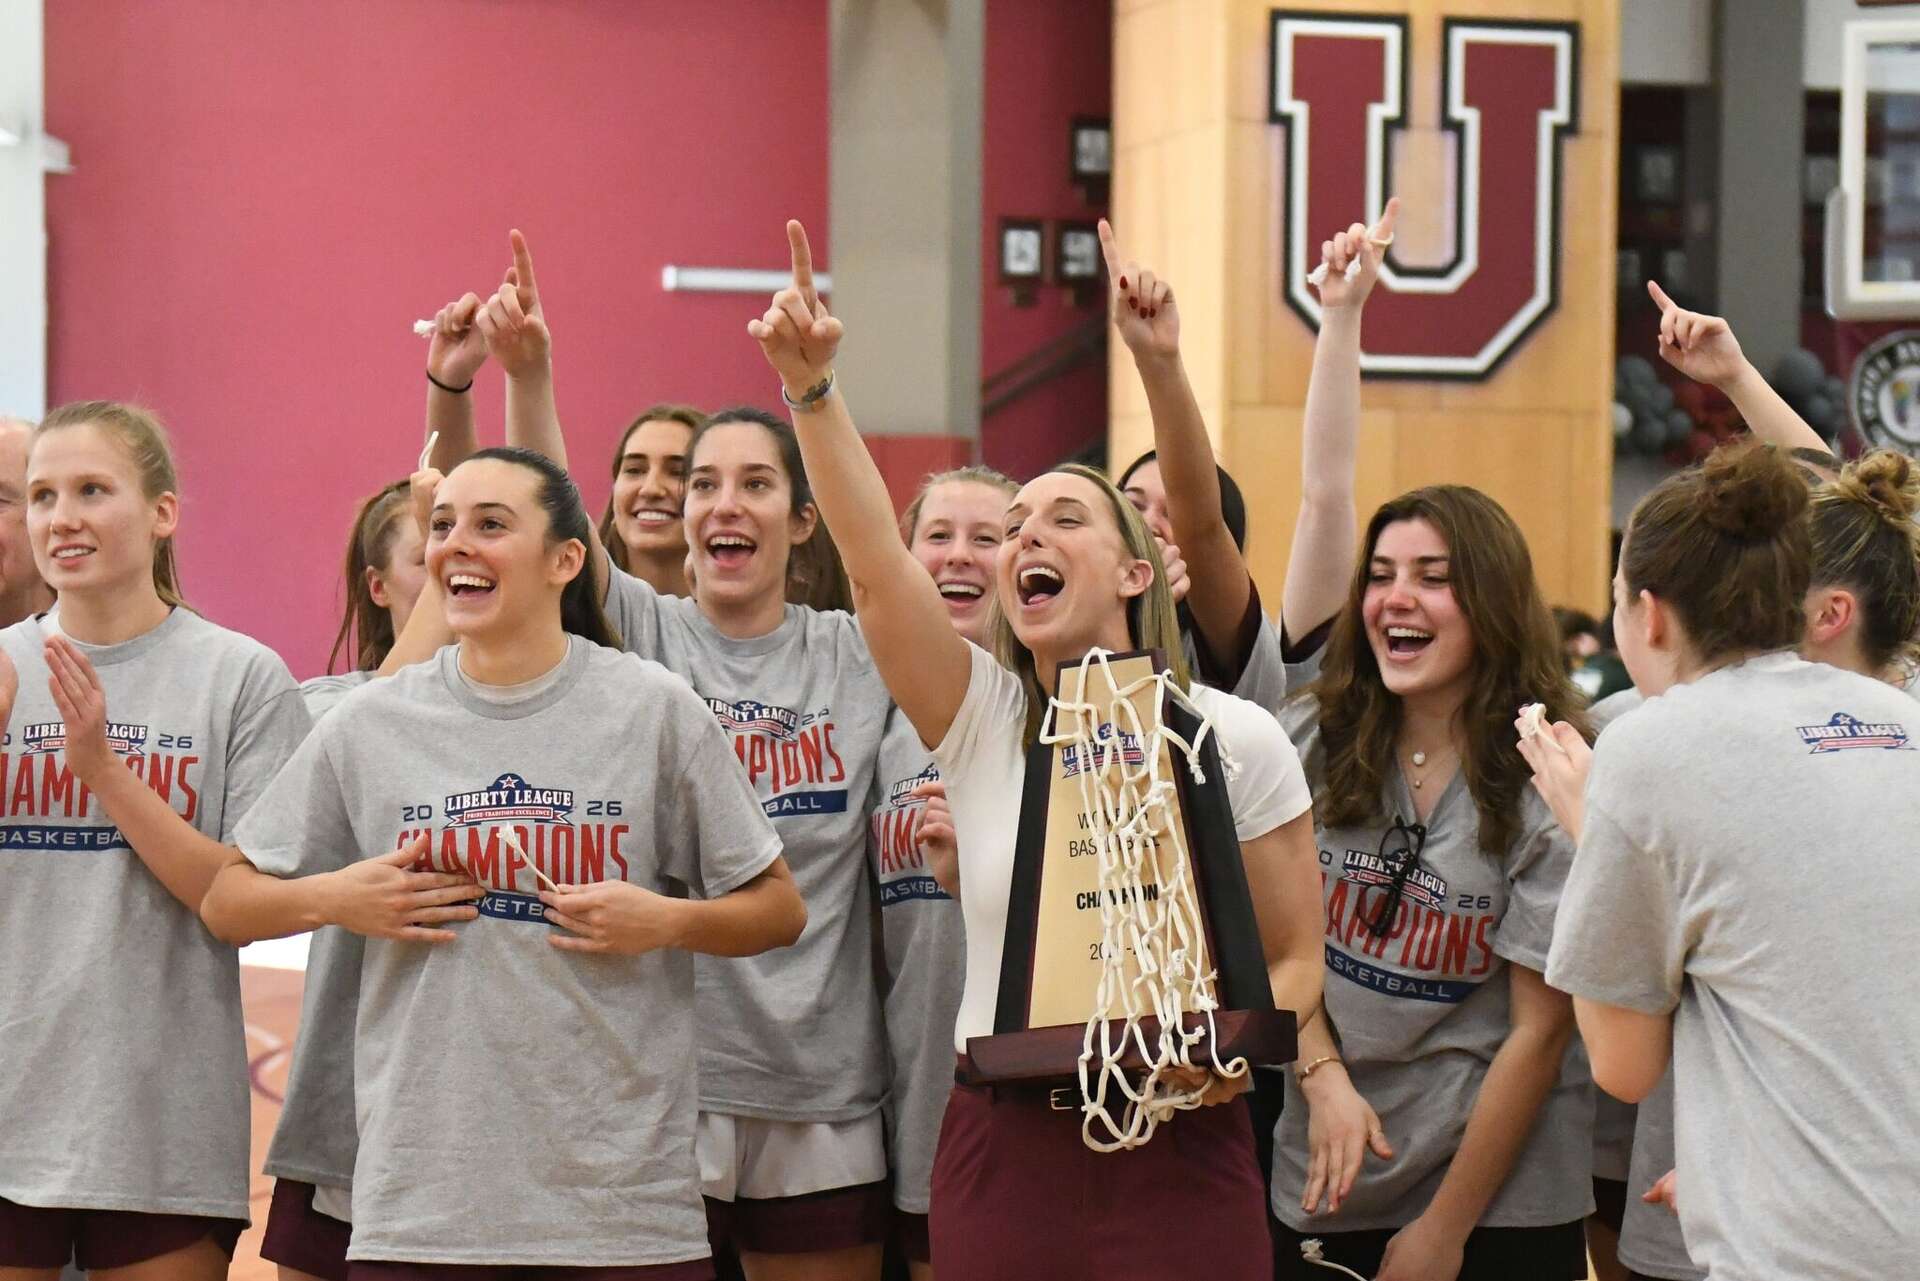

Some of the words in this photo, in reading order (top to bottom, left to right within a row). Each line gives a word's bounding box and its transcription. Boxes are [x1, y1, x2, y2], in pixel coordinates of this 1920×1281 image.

[1269, 10, 1581, 381] U
[709, 698, 750, 721] IBERTY
[754, 706, 797, 728] LEAGUE
[24, 723, 66, 740] LIBER
[158, 733, 193, 749] 26
[446, 790, 509, 812] LIBERTY
[514, 788, 573, 807] LEAGUE
[586, 800, 623, 816] 26
[403, 805, 433, 821] 20
[0, 830, 124, 846] BASKETBA
[1458, 894, 1492, 910] 26
[1320, 872, 1494, 976] AMPIONS
[1326, 951, 1451, 998] ASKETBALL
